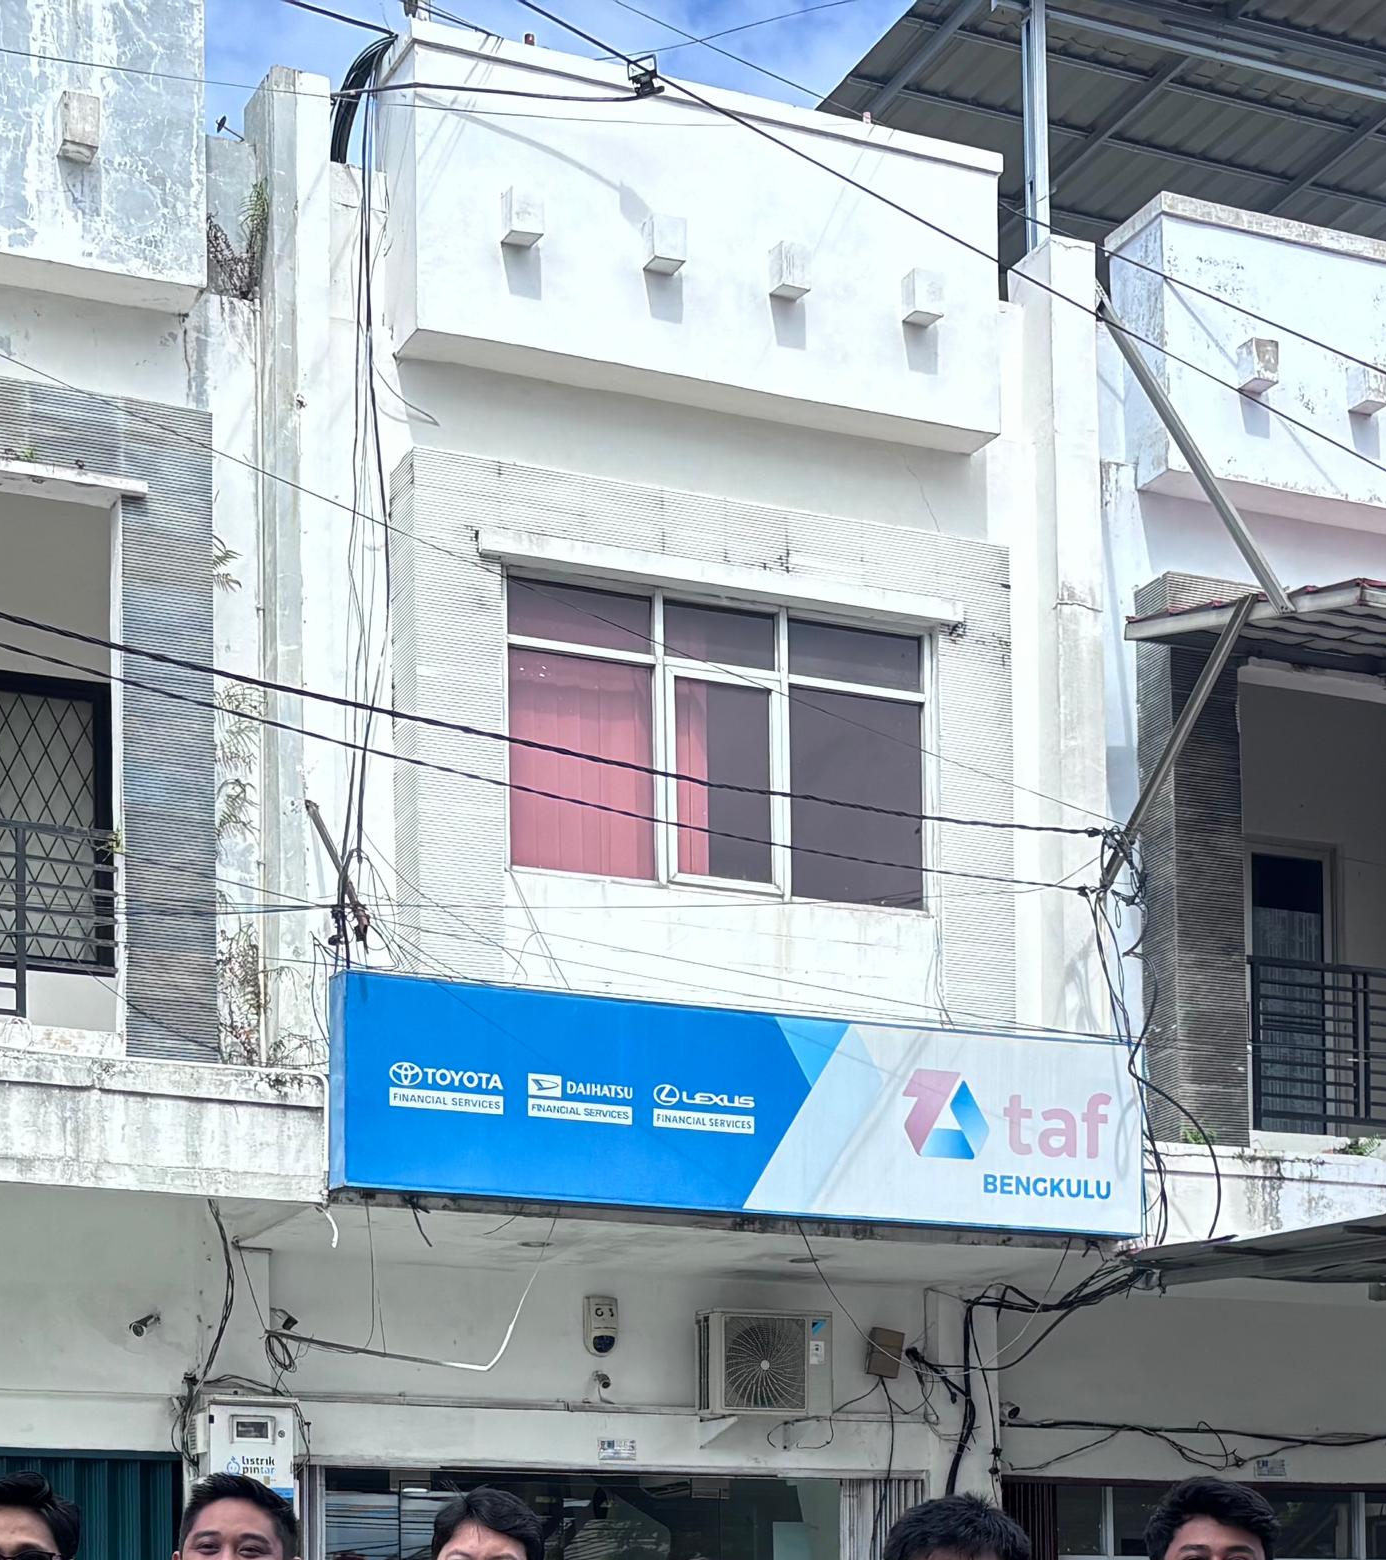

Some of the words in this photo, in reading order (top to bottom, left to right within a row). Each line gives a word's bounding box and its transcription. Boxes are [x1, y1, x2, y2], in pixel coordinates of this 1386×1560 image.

[423, 1068, 504, 1090] TOYOTA
[566, 1081, 633, 1099] DAIHATSU
[393, 1092, 448, 1107] FINANCIAL
[451, 1097, 501, 1110] SERVICES
[682, 1091, 755, 1109] LEXUS
[531, 1103, 581, 1117] FINANCIAL
[584, 1108, 629, 1121] SERVICES
[656, 1113, 707, 1127] FINANCIAL
[709, 1118, 752, 1130] SERVICES
[1003, 1092, 1111, 1159] taf
[982, 1173, 1112, 1200] BENGKULU
